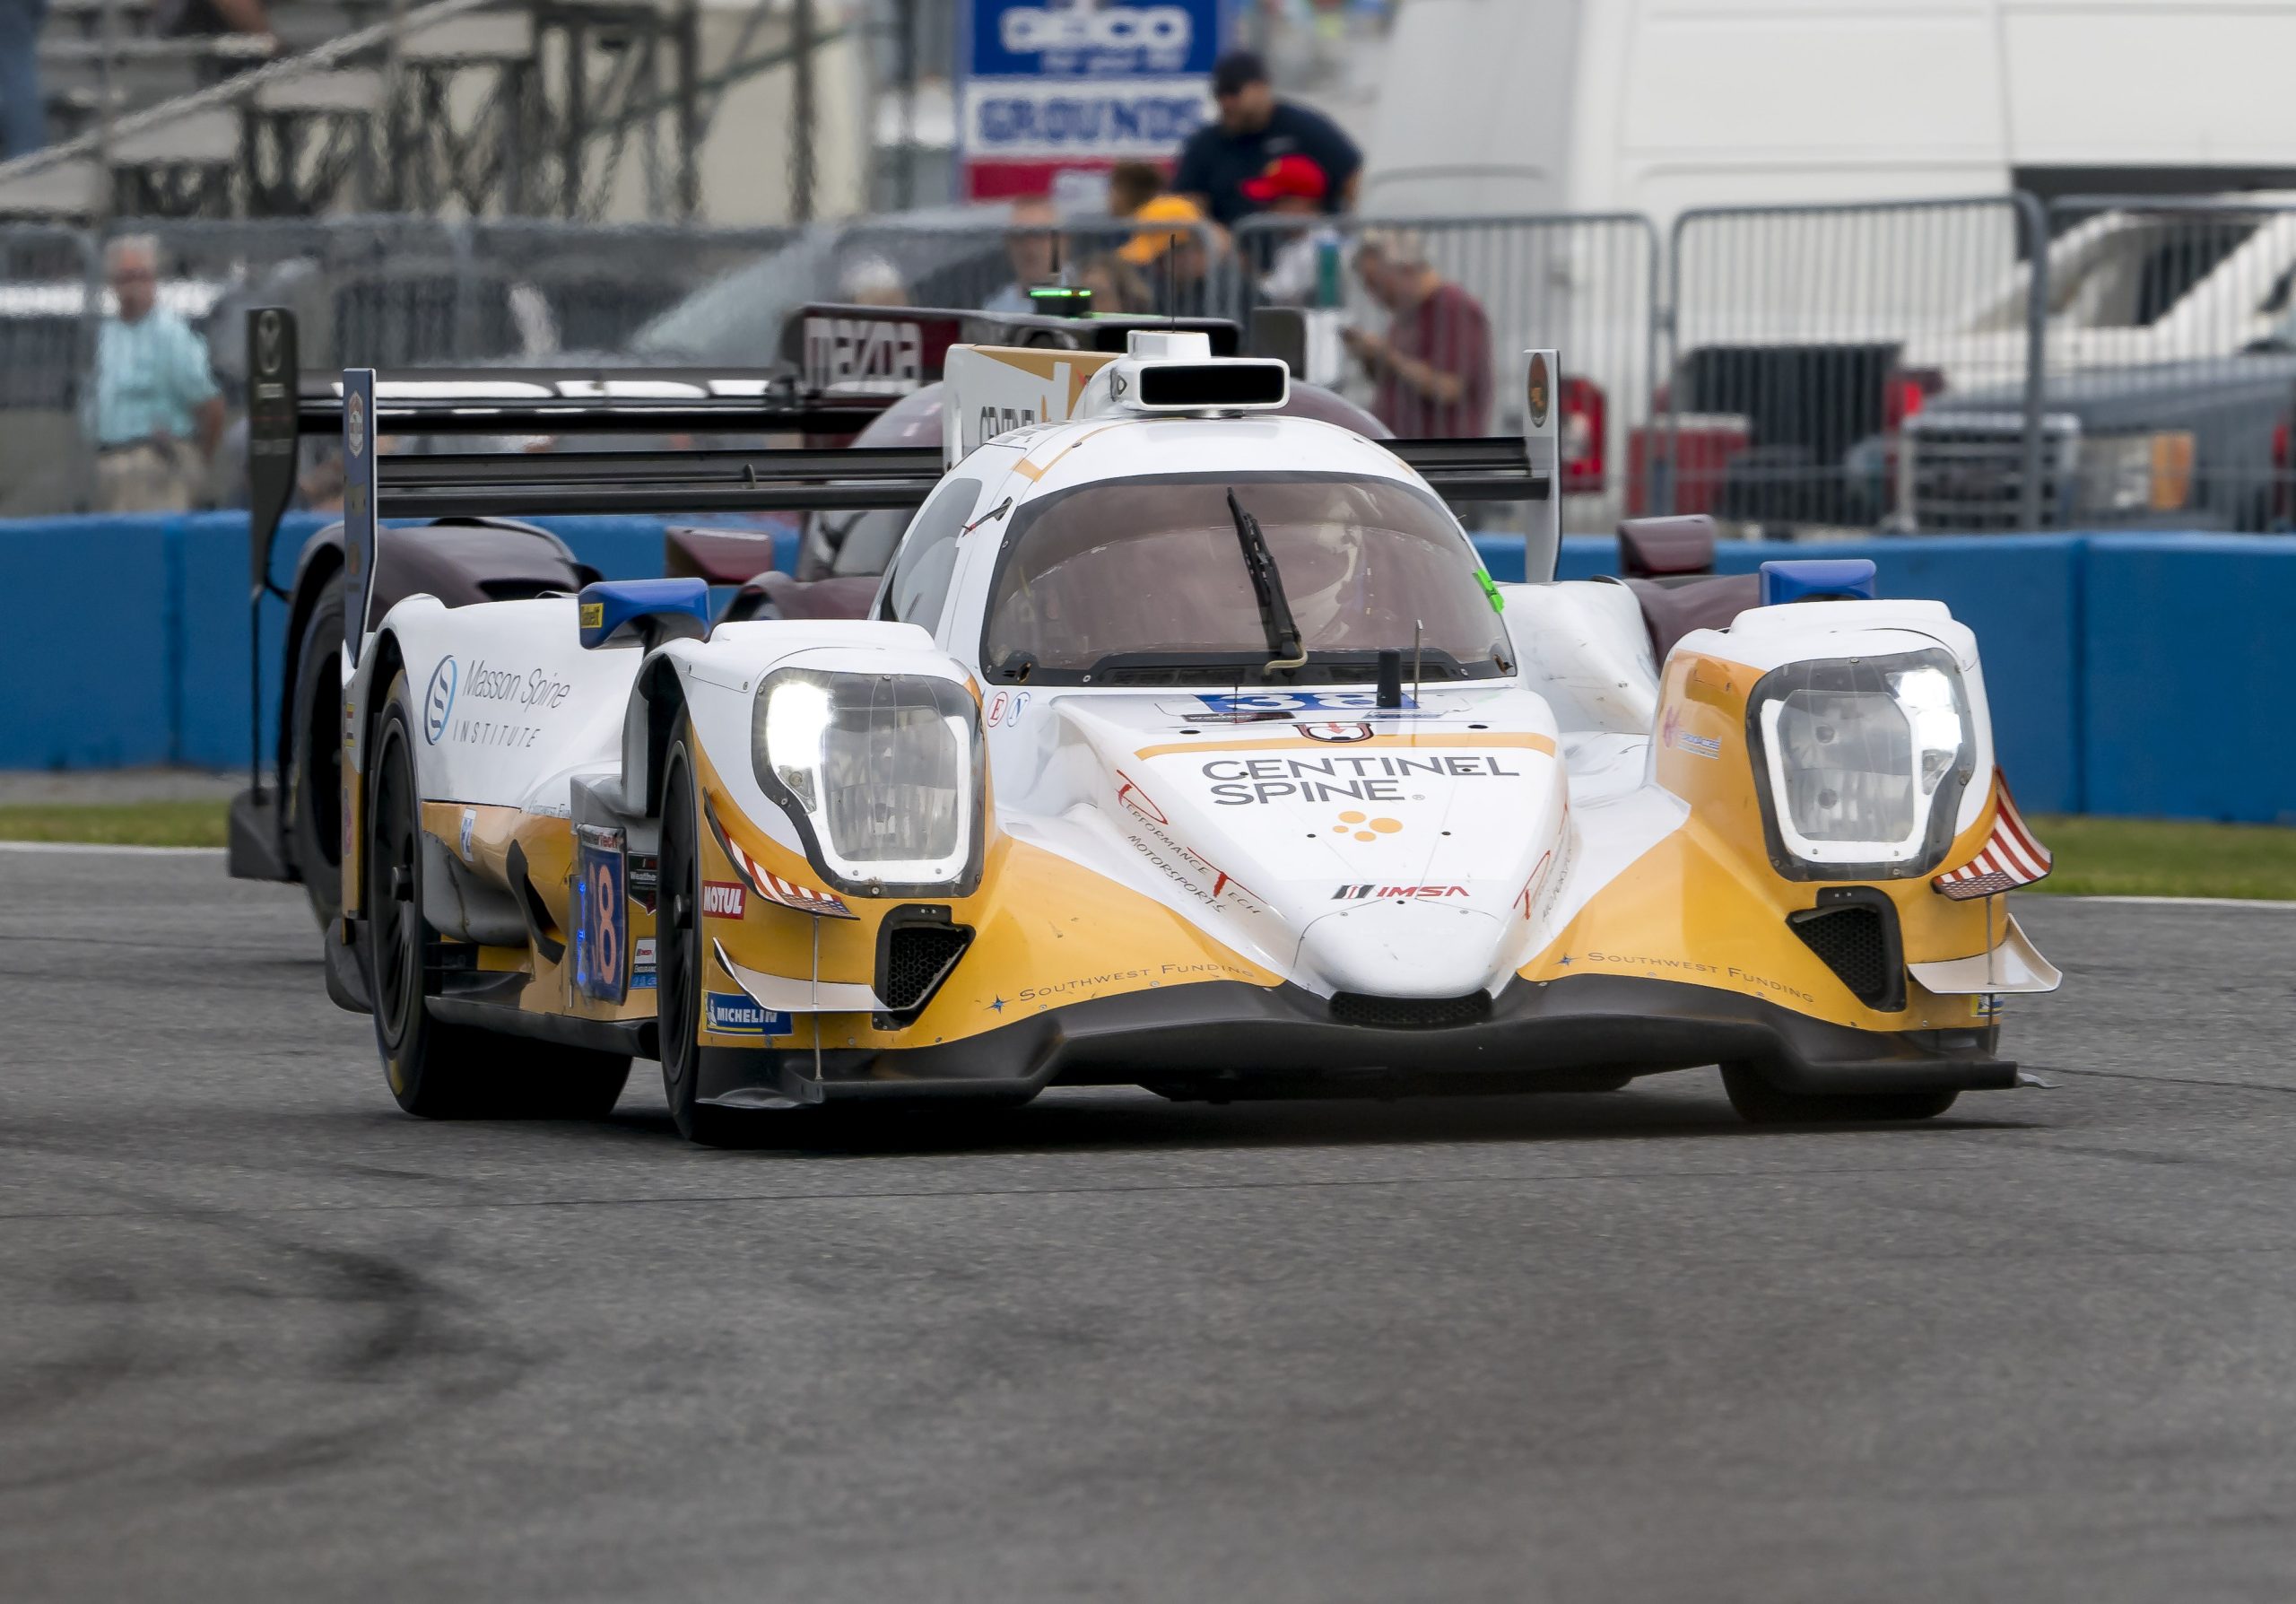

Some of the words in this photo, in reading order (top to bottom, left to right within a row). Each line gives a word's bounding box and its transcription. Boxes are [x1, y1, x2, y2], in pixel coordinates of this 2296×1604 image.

[462, 659, 521, 702] Masson
[520, 667, 570, 713] Spine
[1219, 692, 1379, 710] 38
[452, 719, 541, 748] INSTITUTE
[1202, 756, 1520, 781] CENTINEL
[1210, 780, 1405, 806] SPINE
[1127, 834, 1227, 914] MOTORSPORTS
[703, 885, 742, 915] MOTUL
[1376, 885, 1470, 897] IMSA
[1019, 969, 1151, 1002] SOUTHWEST
[1161, 963, 1255, 978] FUNDING
[1587, 952, 1719, 974] SOUTHWEST
[1726, 967, 1815, 1004] FUNDING
[717, 1006, 778, 1023] MICHELIN
